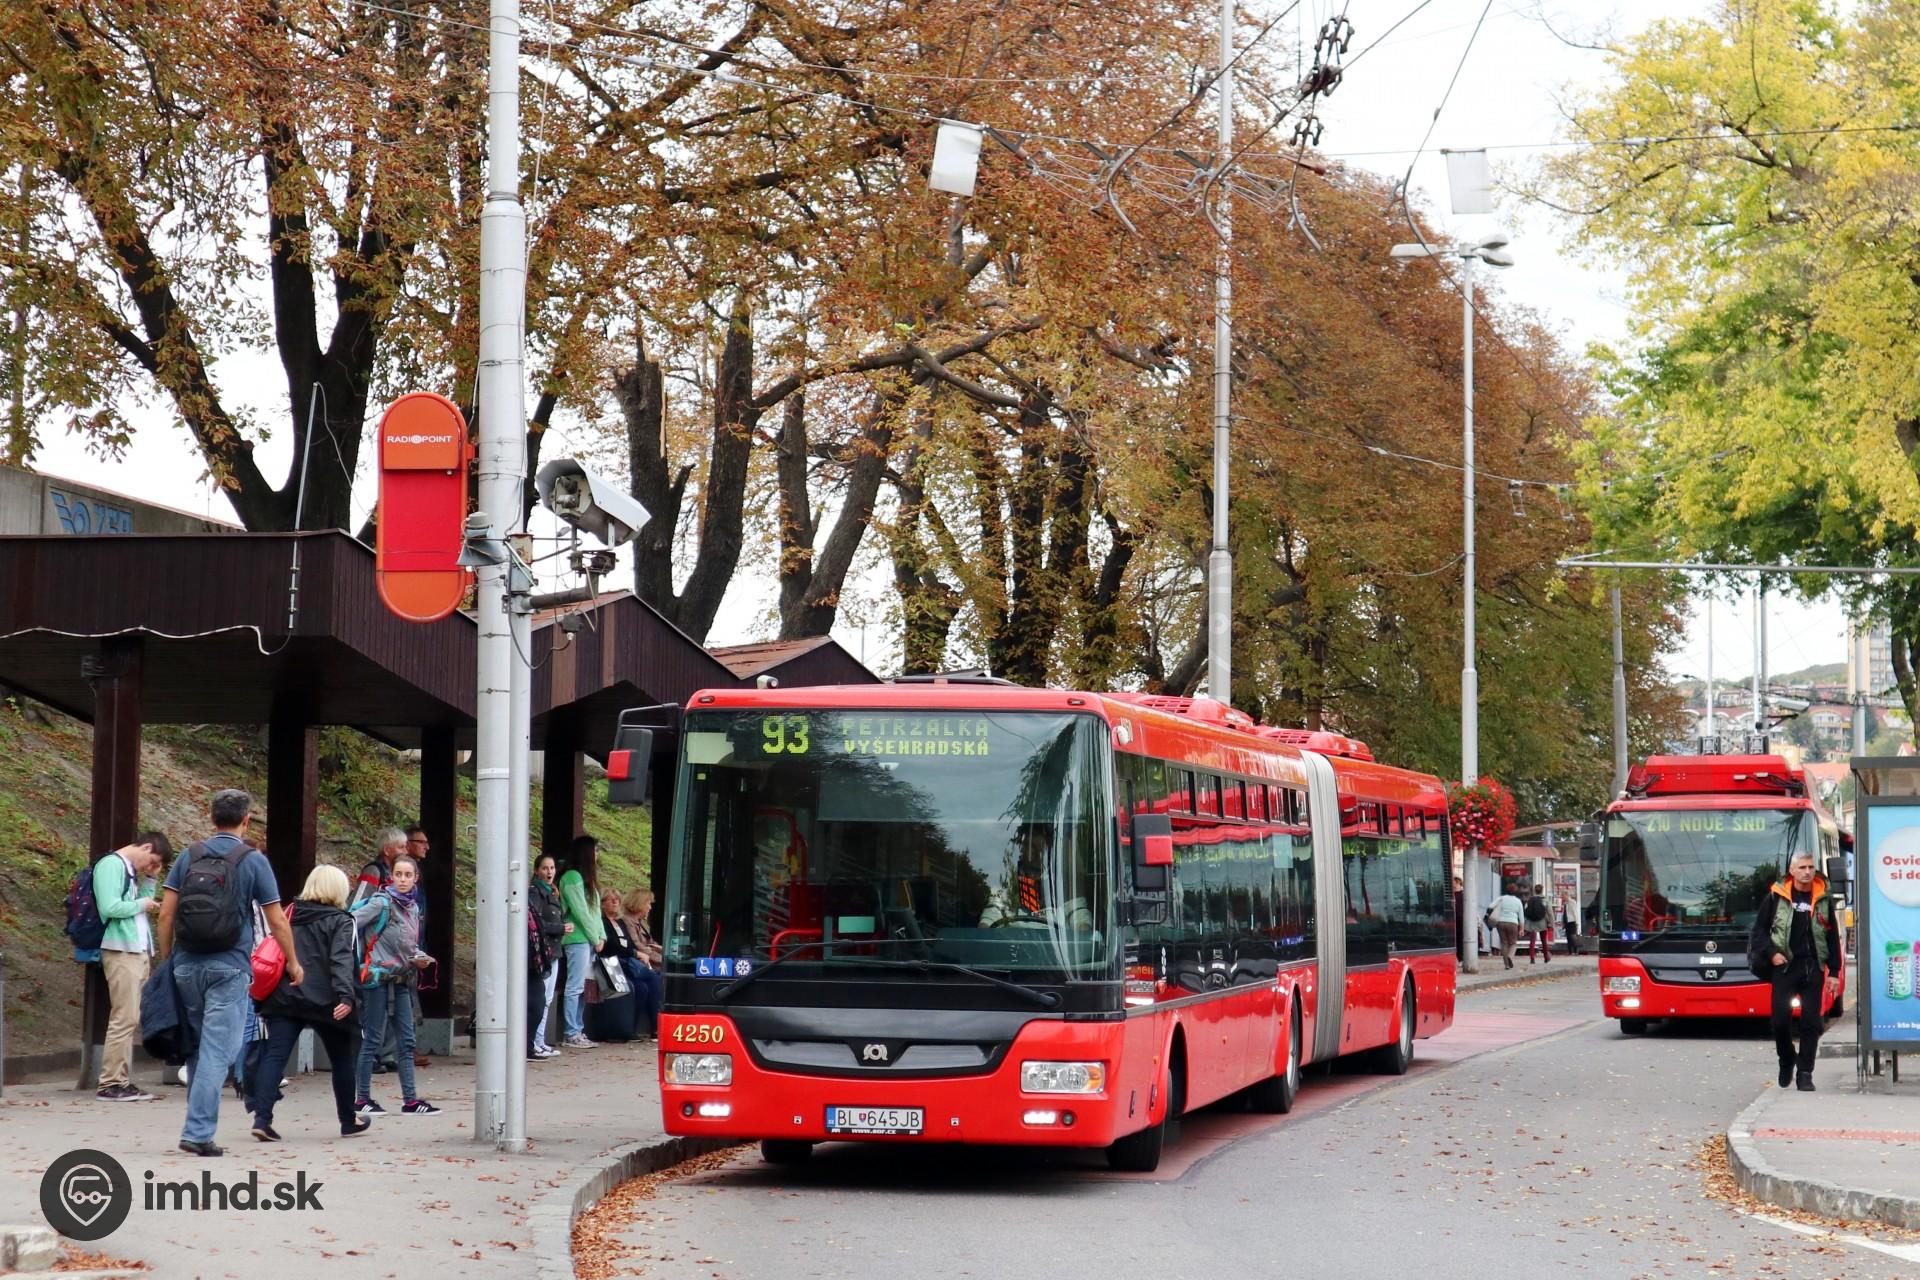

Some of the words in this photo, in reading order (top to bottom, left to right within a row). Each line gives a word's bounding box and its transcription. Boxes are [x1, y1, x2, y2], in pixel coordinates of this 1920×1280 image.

[762, 715, 809, 754] 93
[844, 736, 989, 756] VYŠEHRADSKÁ
[1732, 815, 1766, 832] SND
[1890, 869, 1902, 880] si
[1887, 956, 1895, 997] mentos
[672, 1024, 724, 1043] 4250
